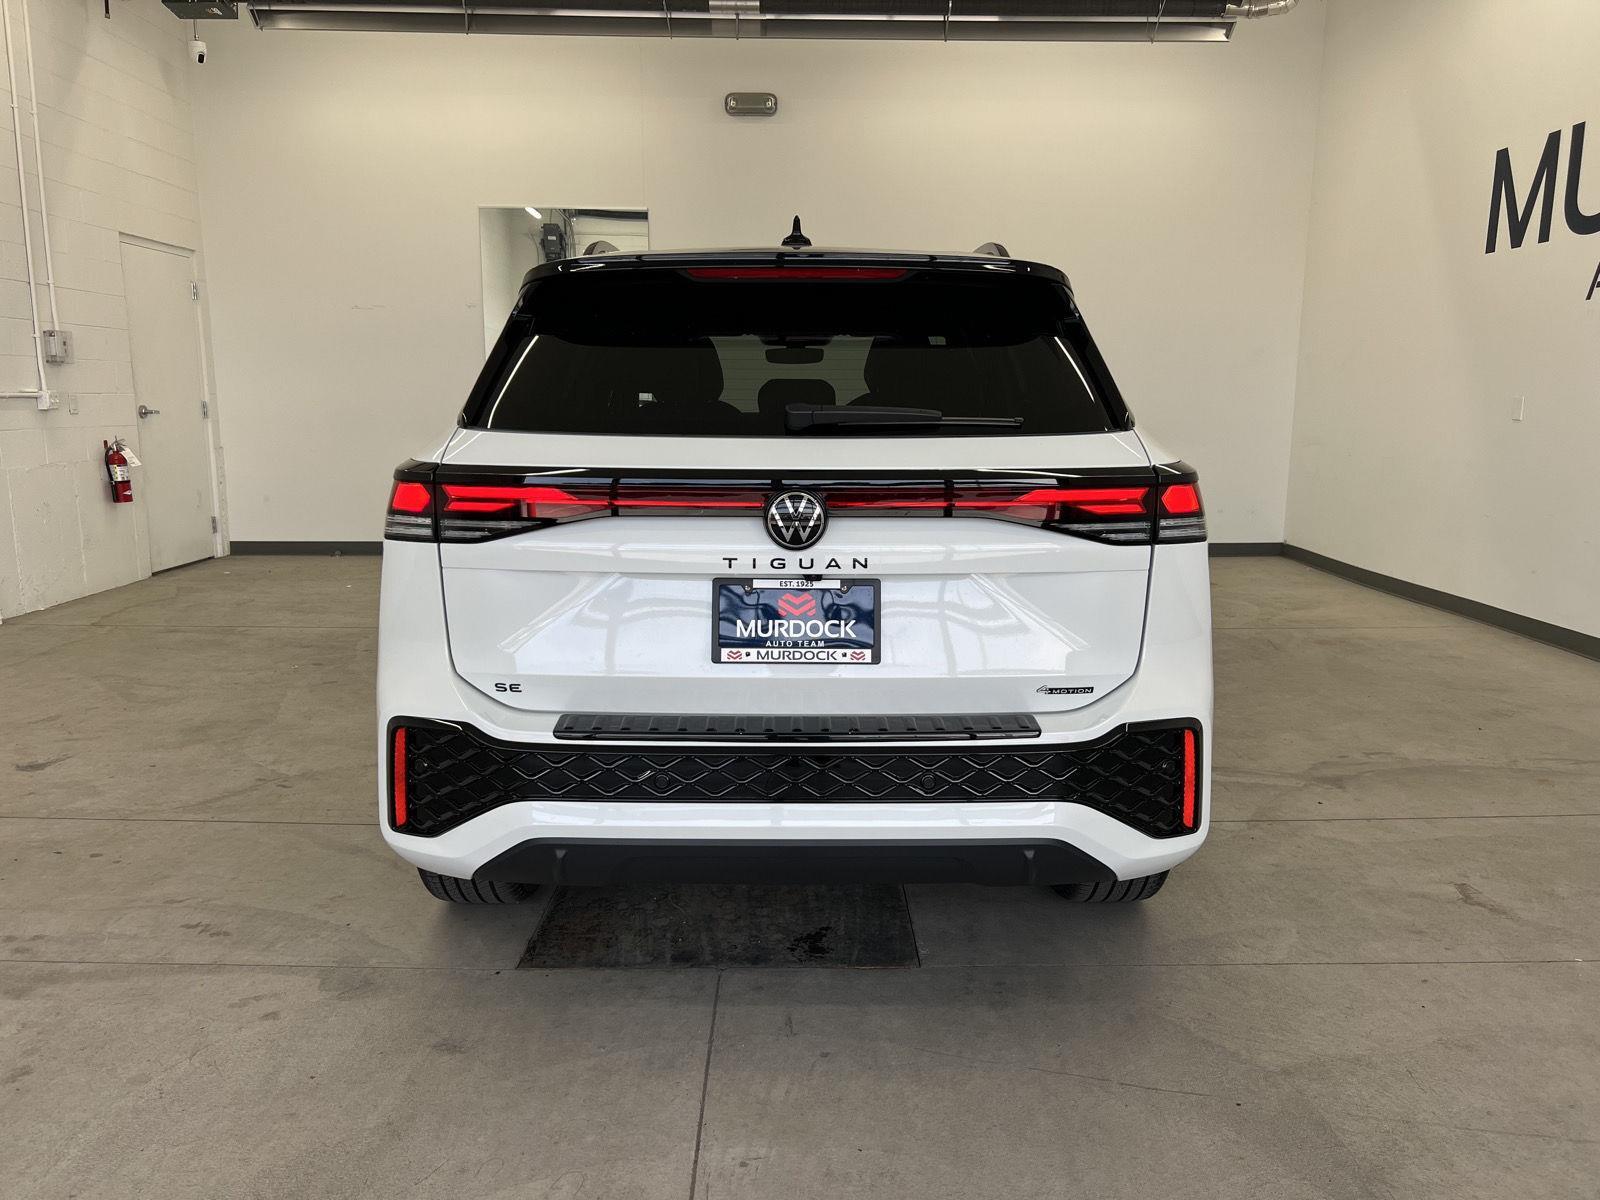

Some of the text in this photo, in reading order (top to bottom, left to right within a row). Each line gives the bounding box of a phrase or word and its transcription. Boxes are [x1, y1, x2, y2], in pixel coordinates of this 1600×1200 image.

[723, 557, 868, 569] TIGUAN
[779, 580, 814, 588] EST. 1925
[736, 619, 857, 638] MURDOCK
[765, 640, 825, 648] AUTO TEAM
[756, 650, 838, 661] MURDOCK
[494, 682, 523, 693] SE
